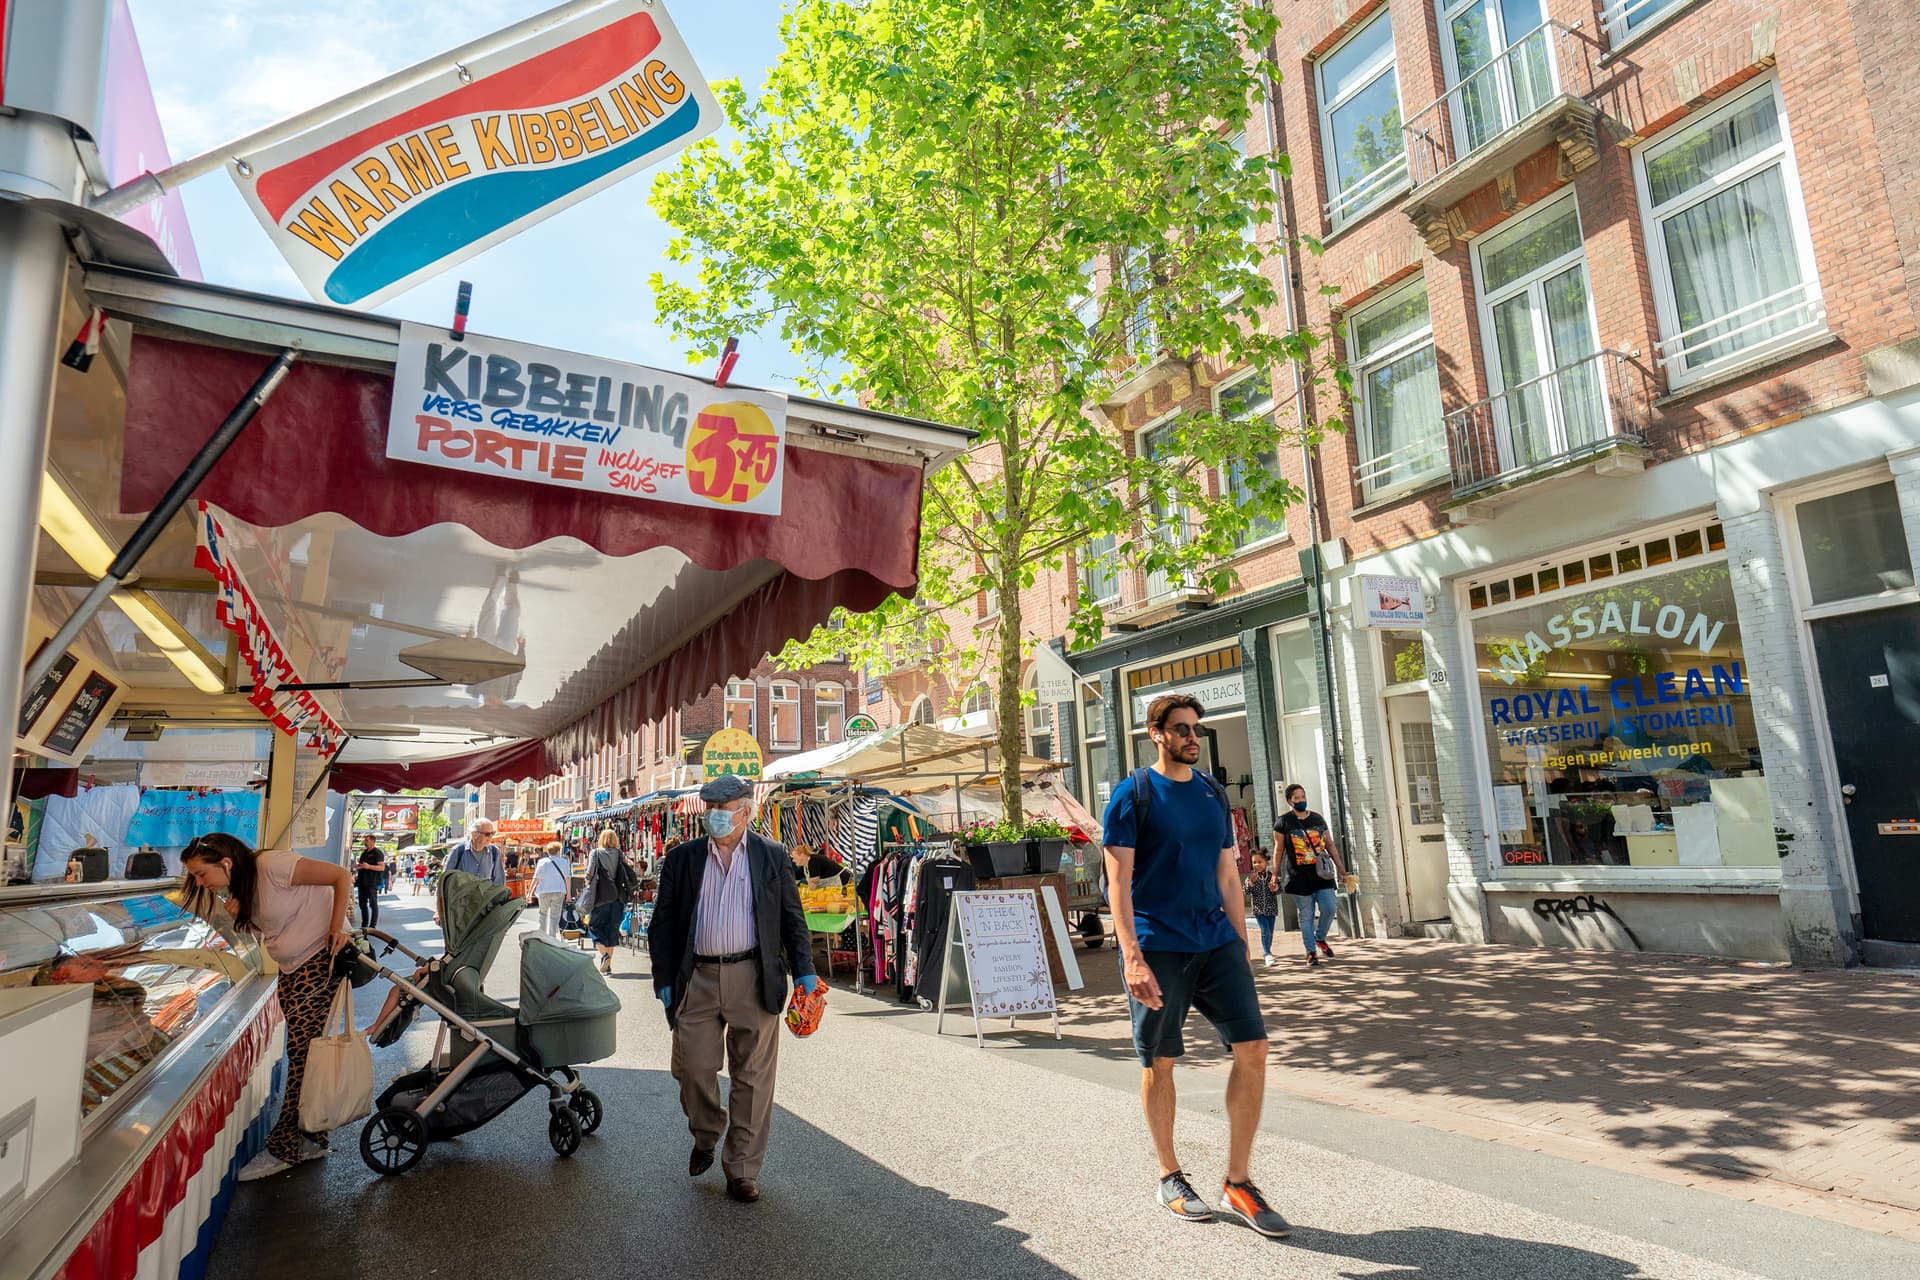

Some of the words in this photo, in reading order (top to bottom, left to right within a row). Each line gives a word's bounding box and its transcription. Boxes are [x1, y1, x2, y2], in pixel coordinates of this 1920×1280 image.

[287, 124, 470, 261] WARME
[472, 58, 685, 170] KIBBELING
[424, 343, 689, 449] KIBBELING
[422, 393, 483, 422] VERS
[490, 408, 622, 446] GEBAKKEN
[415, 414, 588, 482] PORTIE
[598, 447, 684, 480] INCLUSIEF
[609, 471, 657, 494] SAUS
[1490, 600, 1725, 686] WASSALON
[1051, 687, 1073, 697] BACK
[1137, 703, 1145, 715] 2
[1212, 682, 1243, 700] BACK
[1490, 685, 1600, 726] ROYAL
[1609, 661, 1745, 710] CLEAN
[1505, 720, 1601, 747] WASSERIJ
[1623, 703, 1735, 736] STOMERIJ
[705, 750, 759, 761] Herman
[1543, 752, 1585, 771] dagen
[1590, 750, 1615, 767] per
[1619, 744, 1662, 761] week
[1668, 741, 1712, 759] open
[705, 761, 760, 778] KAAS
[500, 821, 525, 830] Orange
[526, 820, 543, 829] Juice
[1504, 851, 1542, 864] OPEN
[978, 908, 984, 918] 2
[986, 907, 1008, 918] THE
[993, 920, 1023, 931] BACK
[993, 974, 1026, 983] LIFESTYLE
[994, 964, 1024, 973] FASHION
